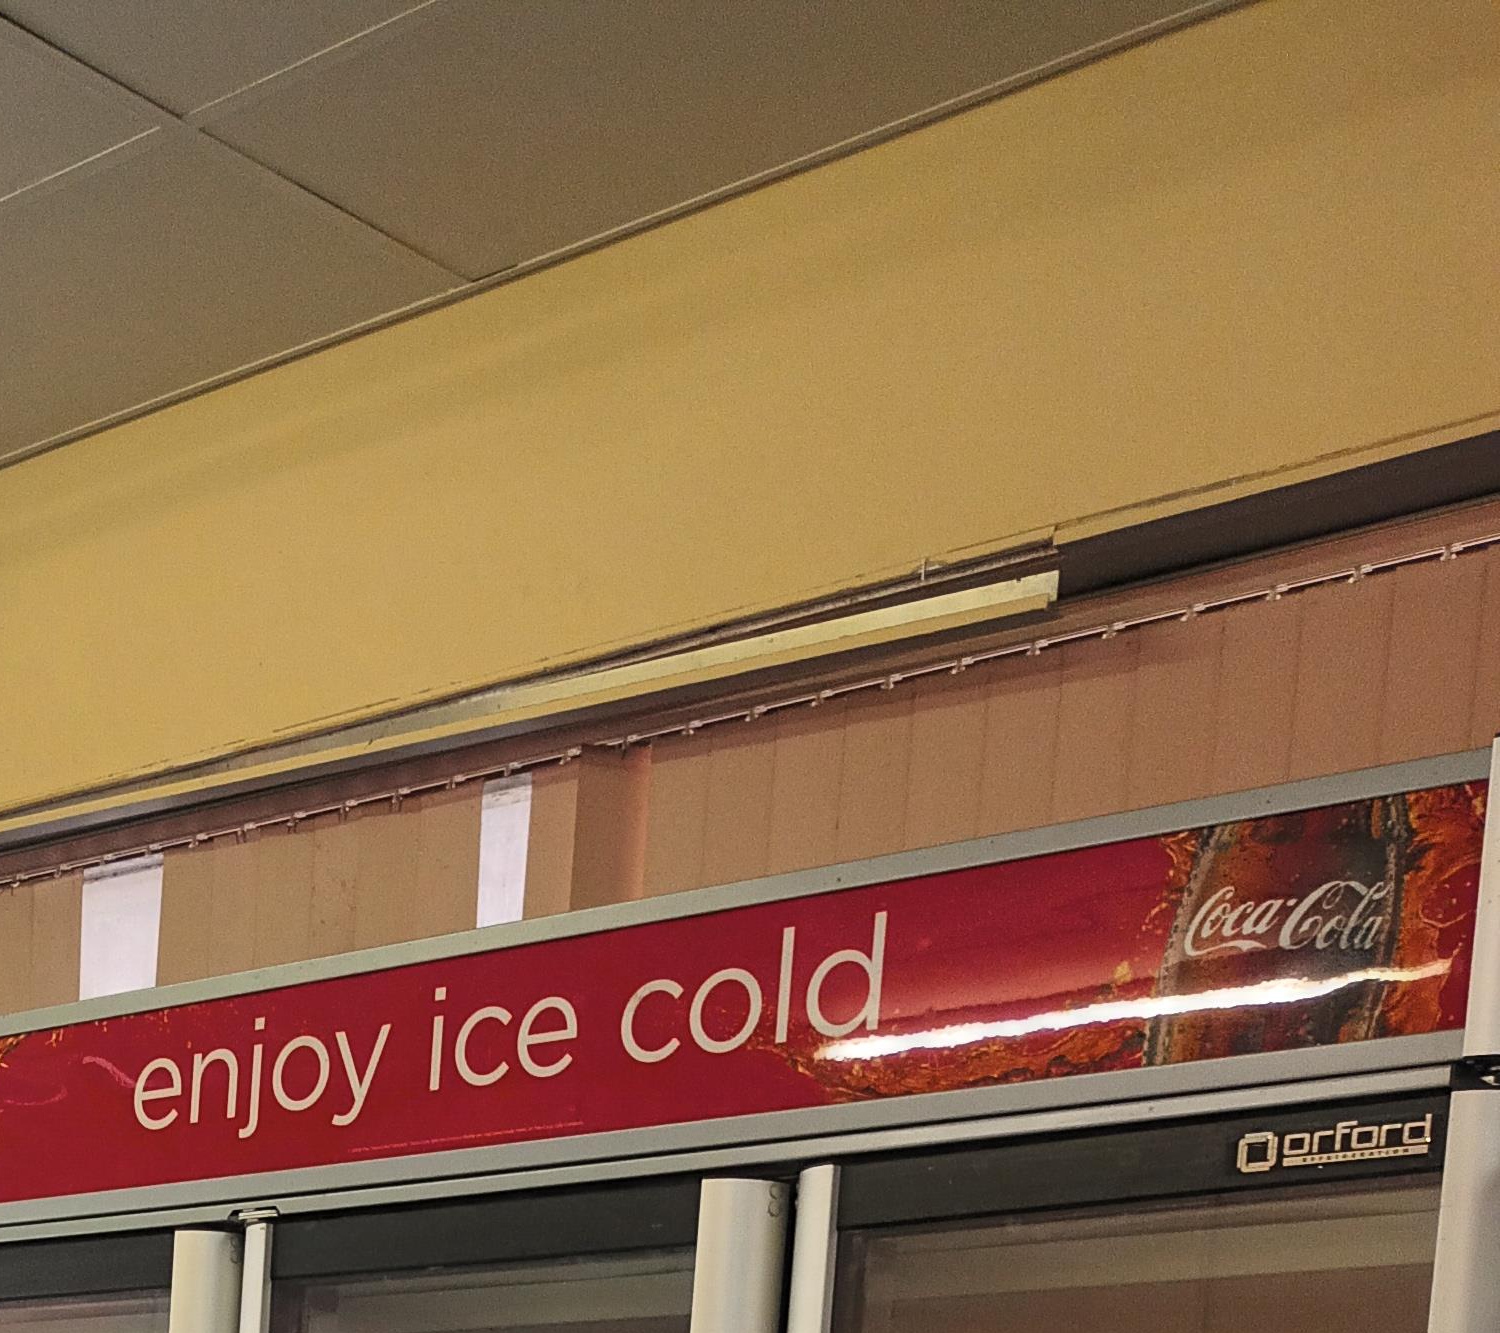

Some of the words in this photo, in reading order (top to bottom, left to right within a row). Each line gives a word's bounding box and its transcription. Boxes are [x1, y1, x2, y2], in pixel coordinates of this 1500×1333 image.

[133, 1016, 391, 1140] enjoy
[428, 986, 579, 1091] ice
[619, 911, 888, 1064] cold
